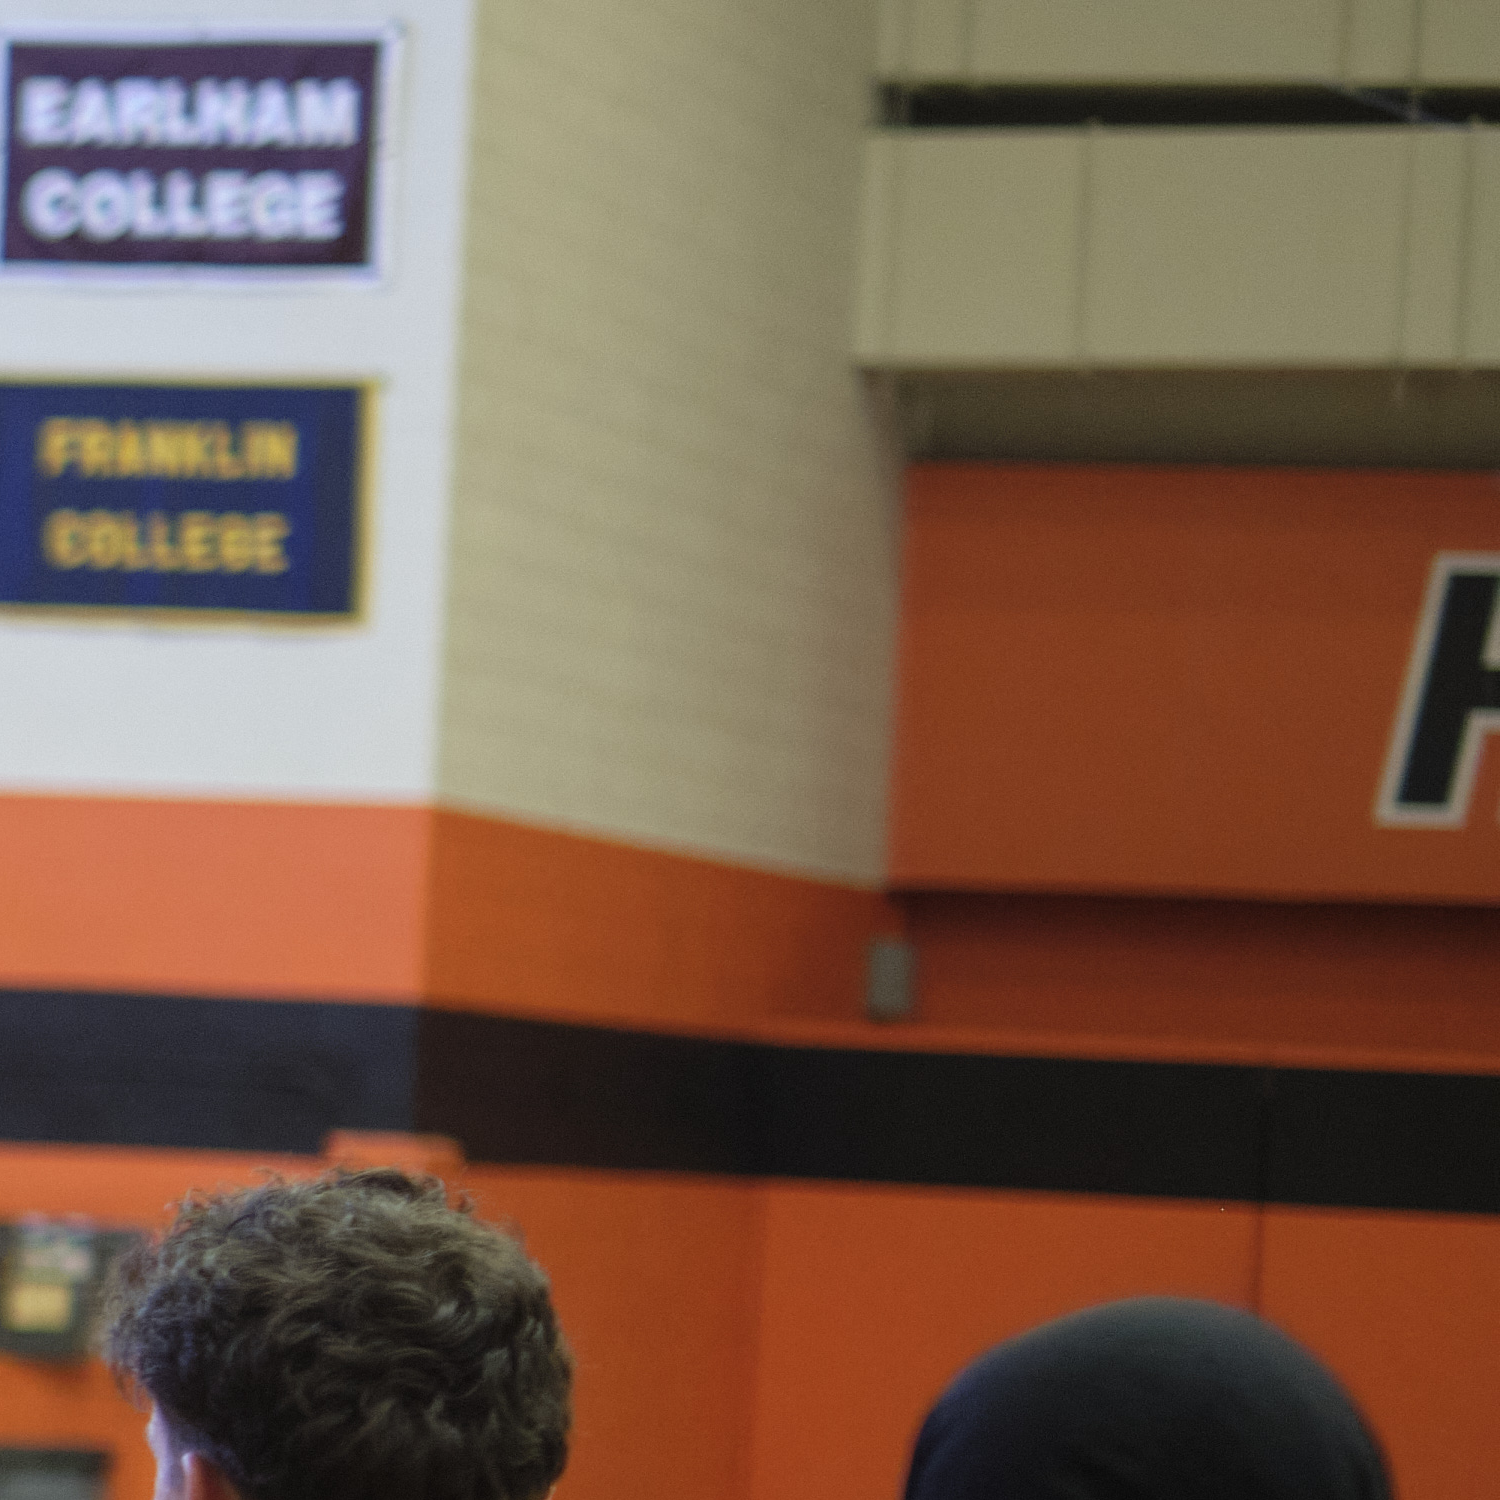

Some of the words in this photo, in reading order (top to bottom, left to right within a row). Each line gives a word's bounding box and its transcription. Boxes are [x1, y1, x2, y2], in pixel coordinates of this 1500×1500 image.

[21, 77, 360, 147] EARLHAM
[22, 168, 345, 242] COLLEGE
[37, 415, 297, 479] FRANKLIN
[45, 509, 290, 574] COLLEGE
